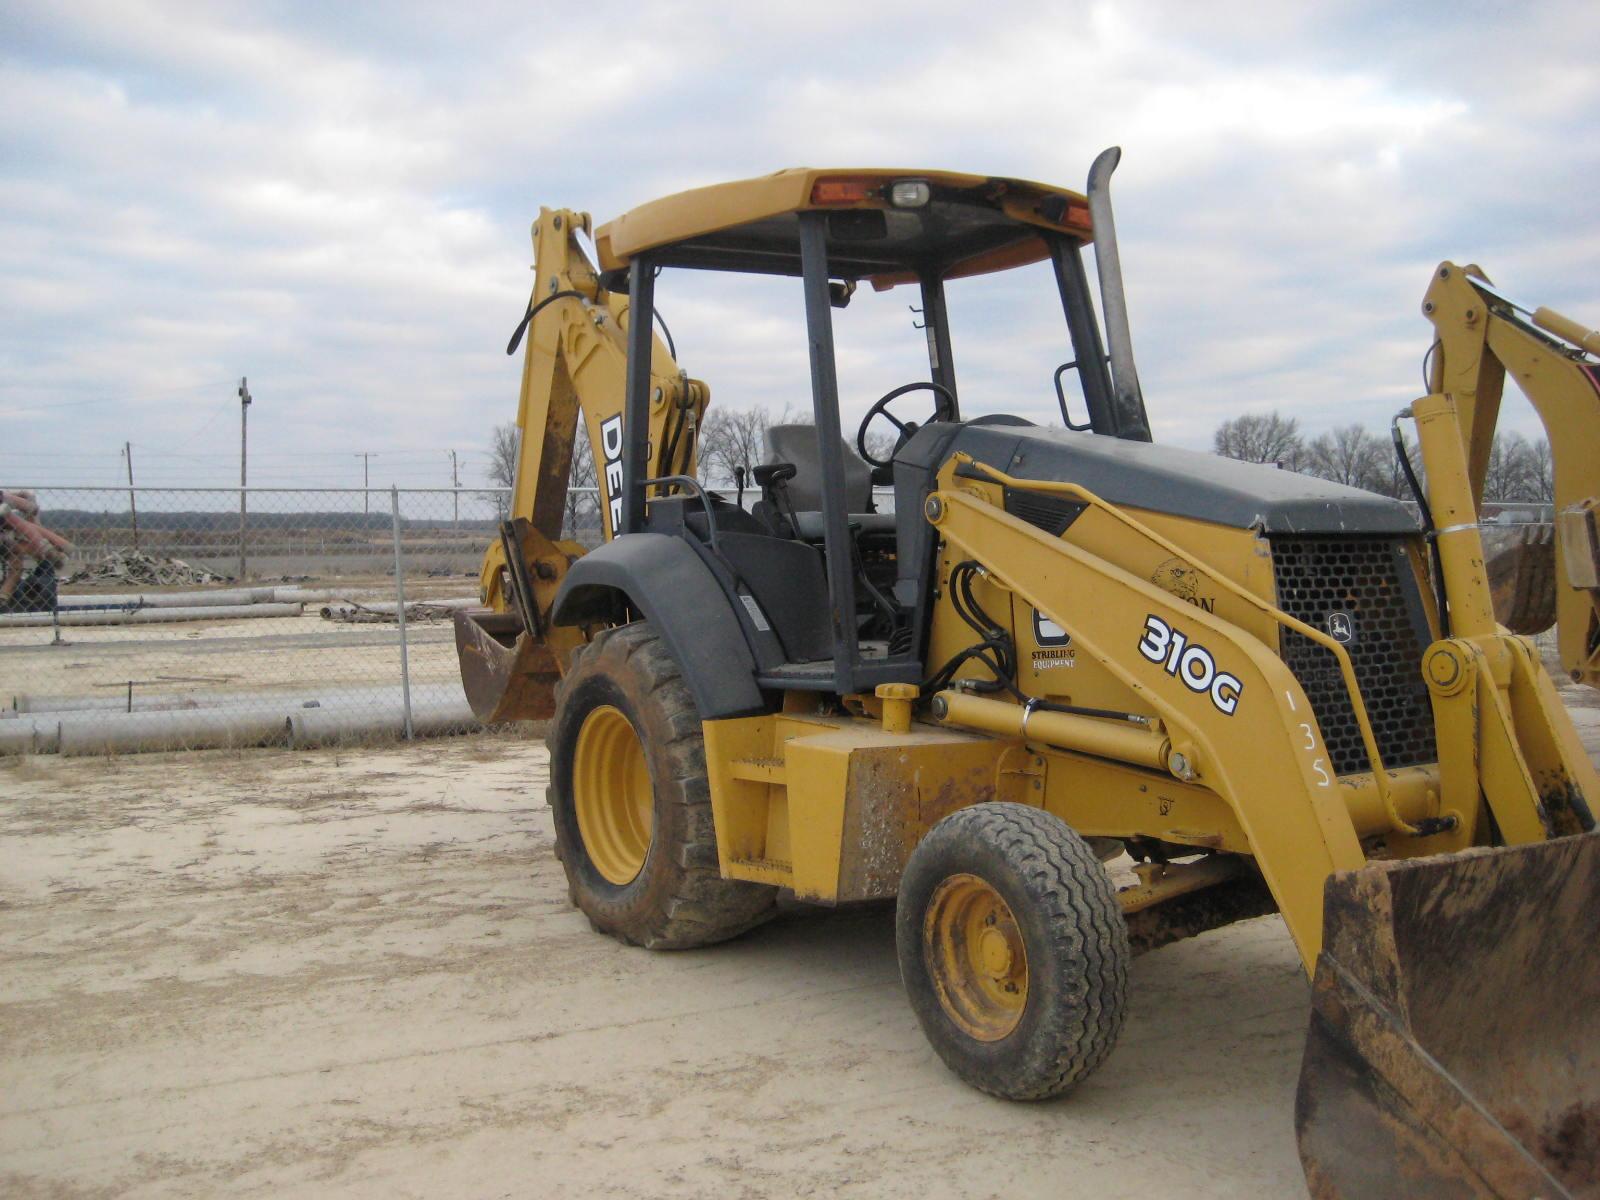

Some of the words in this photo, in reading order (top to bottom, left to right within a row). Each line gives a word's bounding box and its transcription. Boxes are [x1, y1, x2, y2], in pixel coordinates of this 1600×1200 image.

[601, 411, 624, 540] DEE
[1031, 650, 1076, 660] STRIBLING
[1033, 659, 1075, 670] EQUIPMENT
[1138, 613, 1244, 717] 310G
